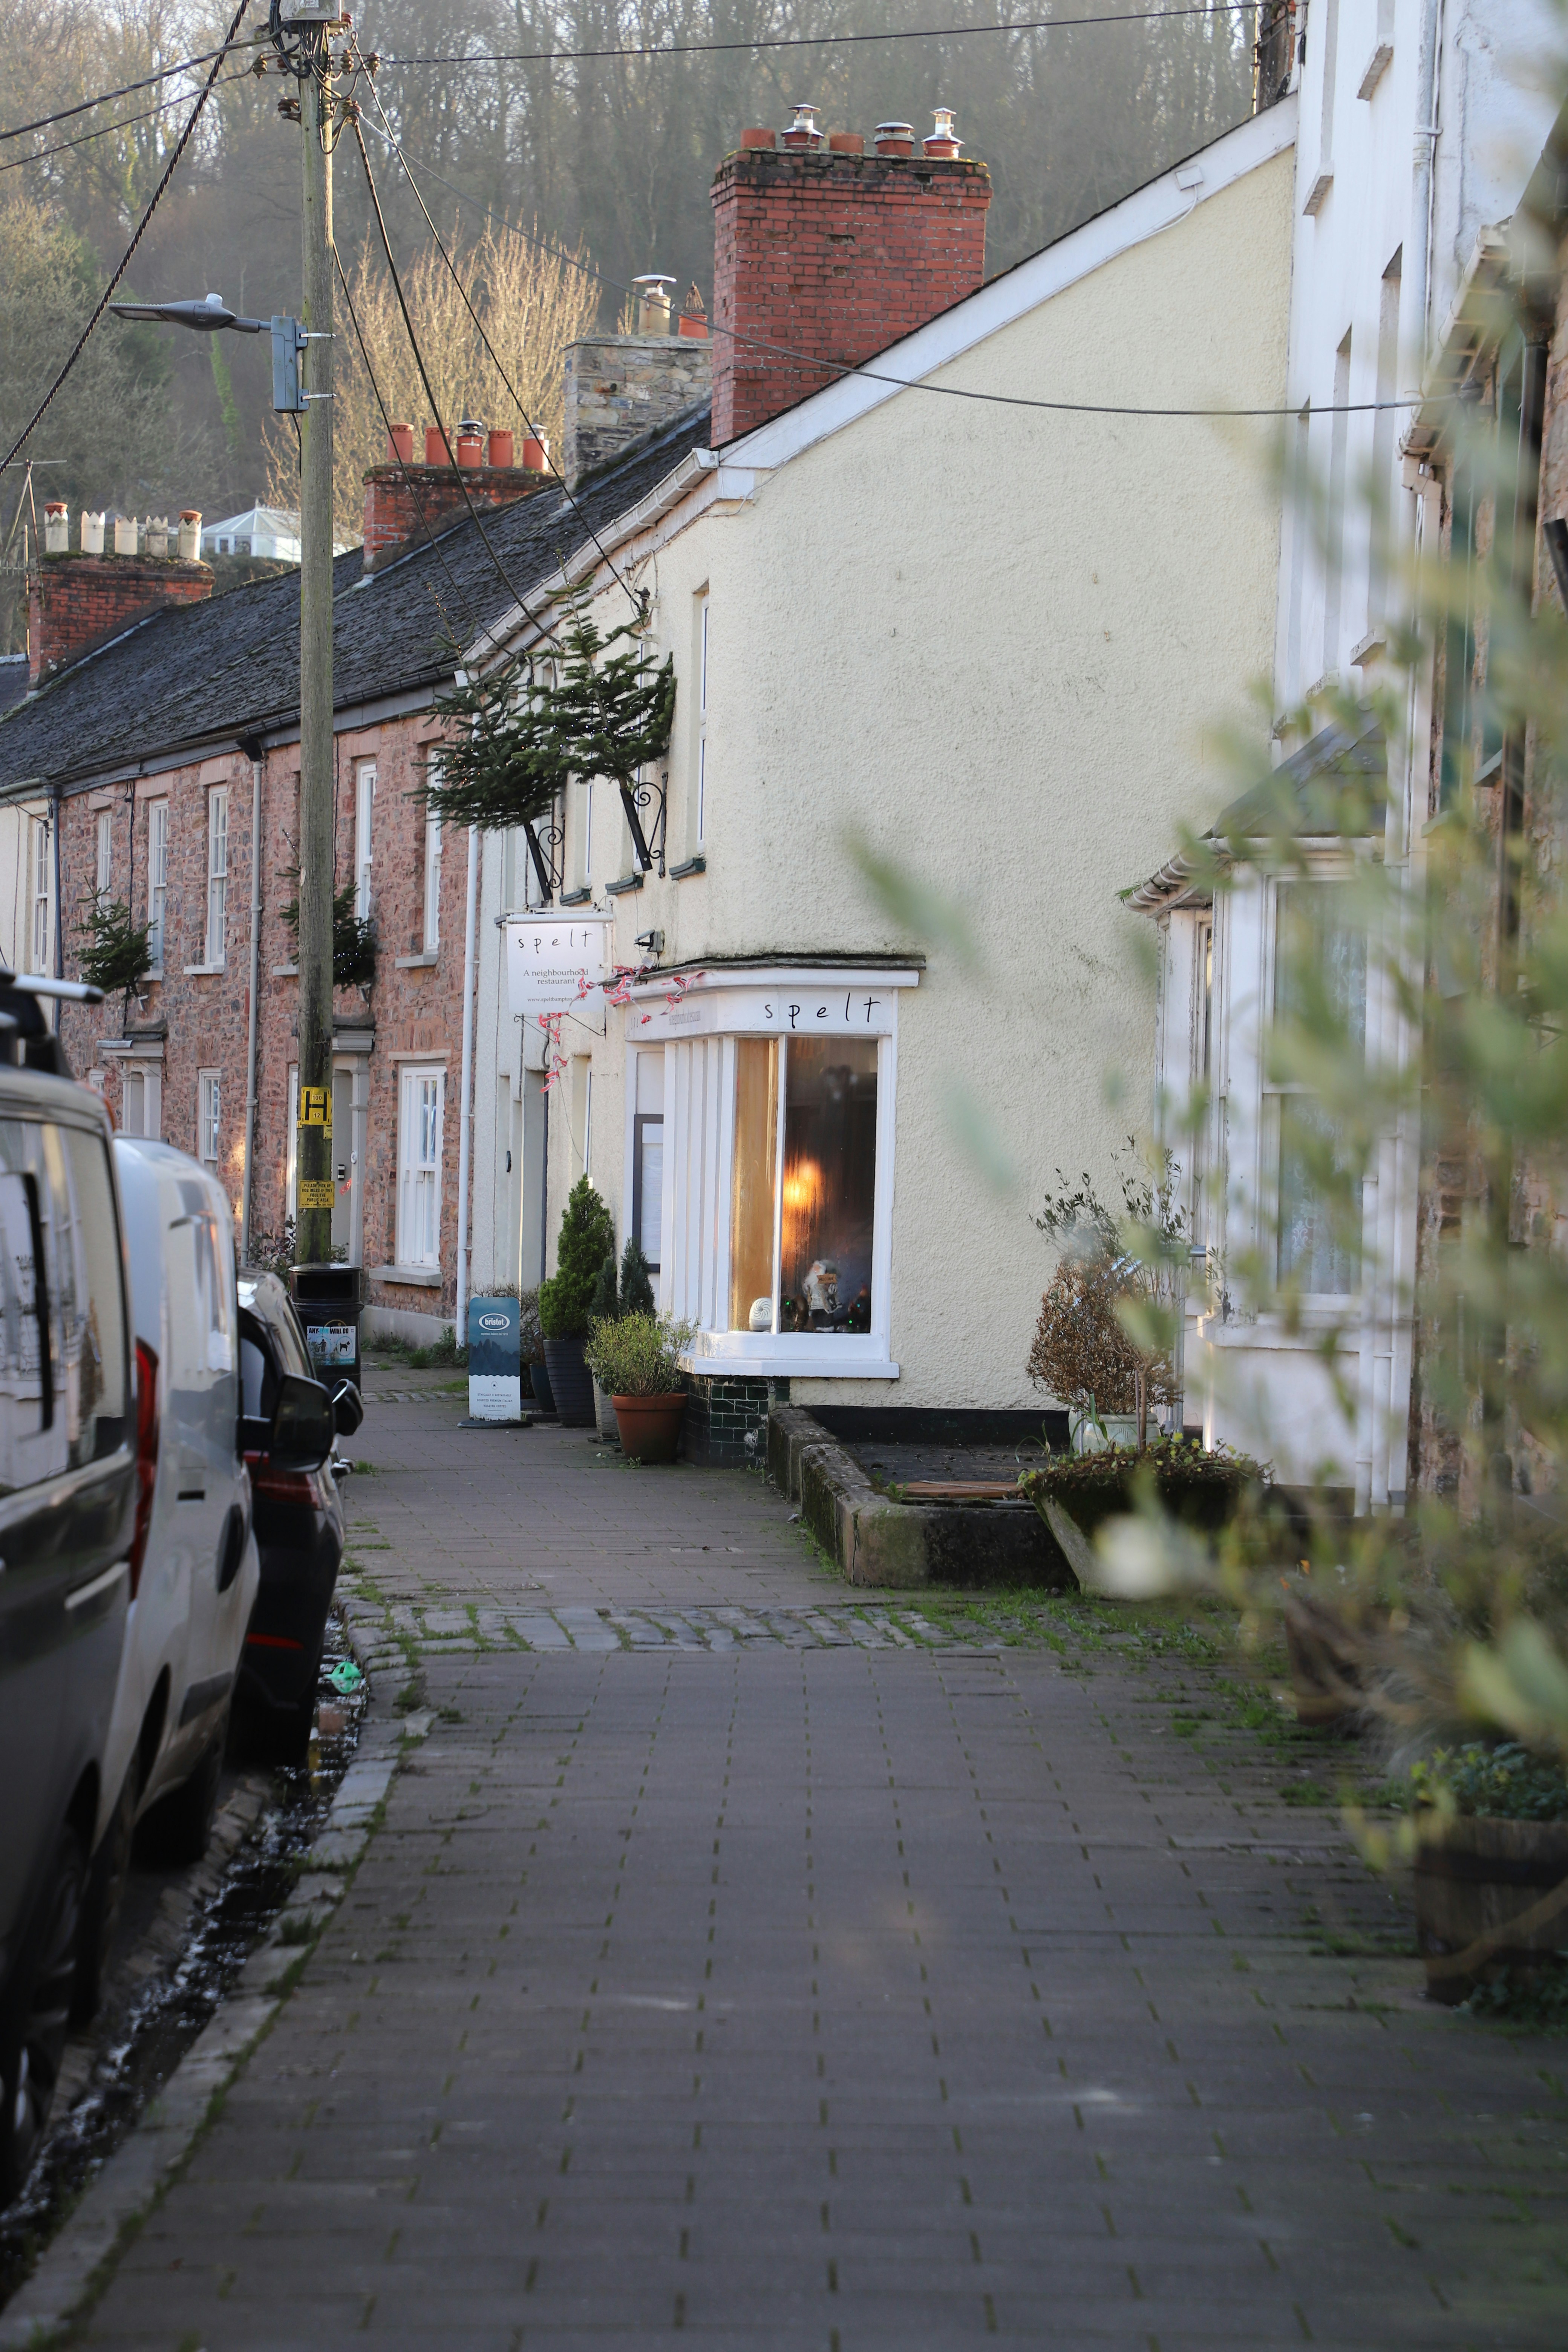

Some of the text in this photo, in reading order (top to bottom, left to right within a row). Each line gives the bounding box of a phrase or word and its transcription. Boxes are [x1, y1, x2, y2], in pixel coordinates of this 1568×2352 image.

[518, 928, 593, 954] spelt
[532, 969, 588, 978] neighbourhood
[765, 992, 881, 1029] spelt
[305, 1091, 327, 1121] H
[485, 1317, 504, 1326] bristot
